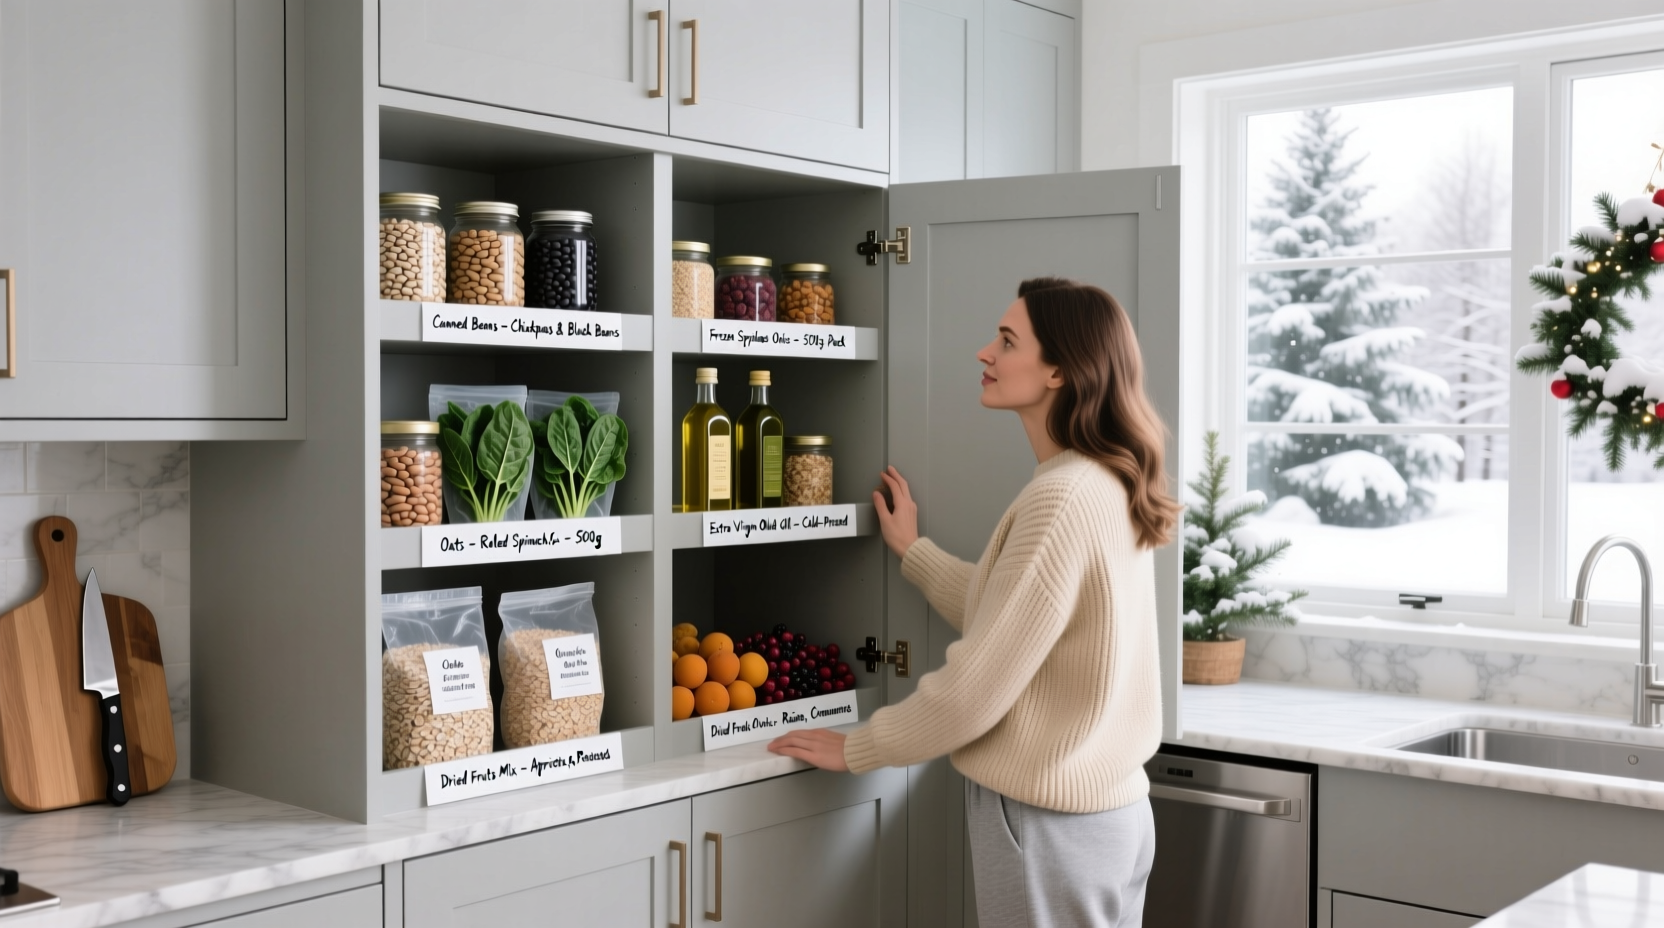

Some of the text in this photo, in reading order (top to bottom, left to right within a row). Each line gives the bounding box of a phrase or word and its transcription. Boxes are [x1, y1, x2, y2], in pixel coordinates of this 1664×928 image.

[471, 316, 499, 332] Beans
[555, 322, 564, 335] &
[440, 536, 465, 552] Oats
[575, 529, 603, 550] 500g
